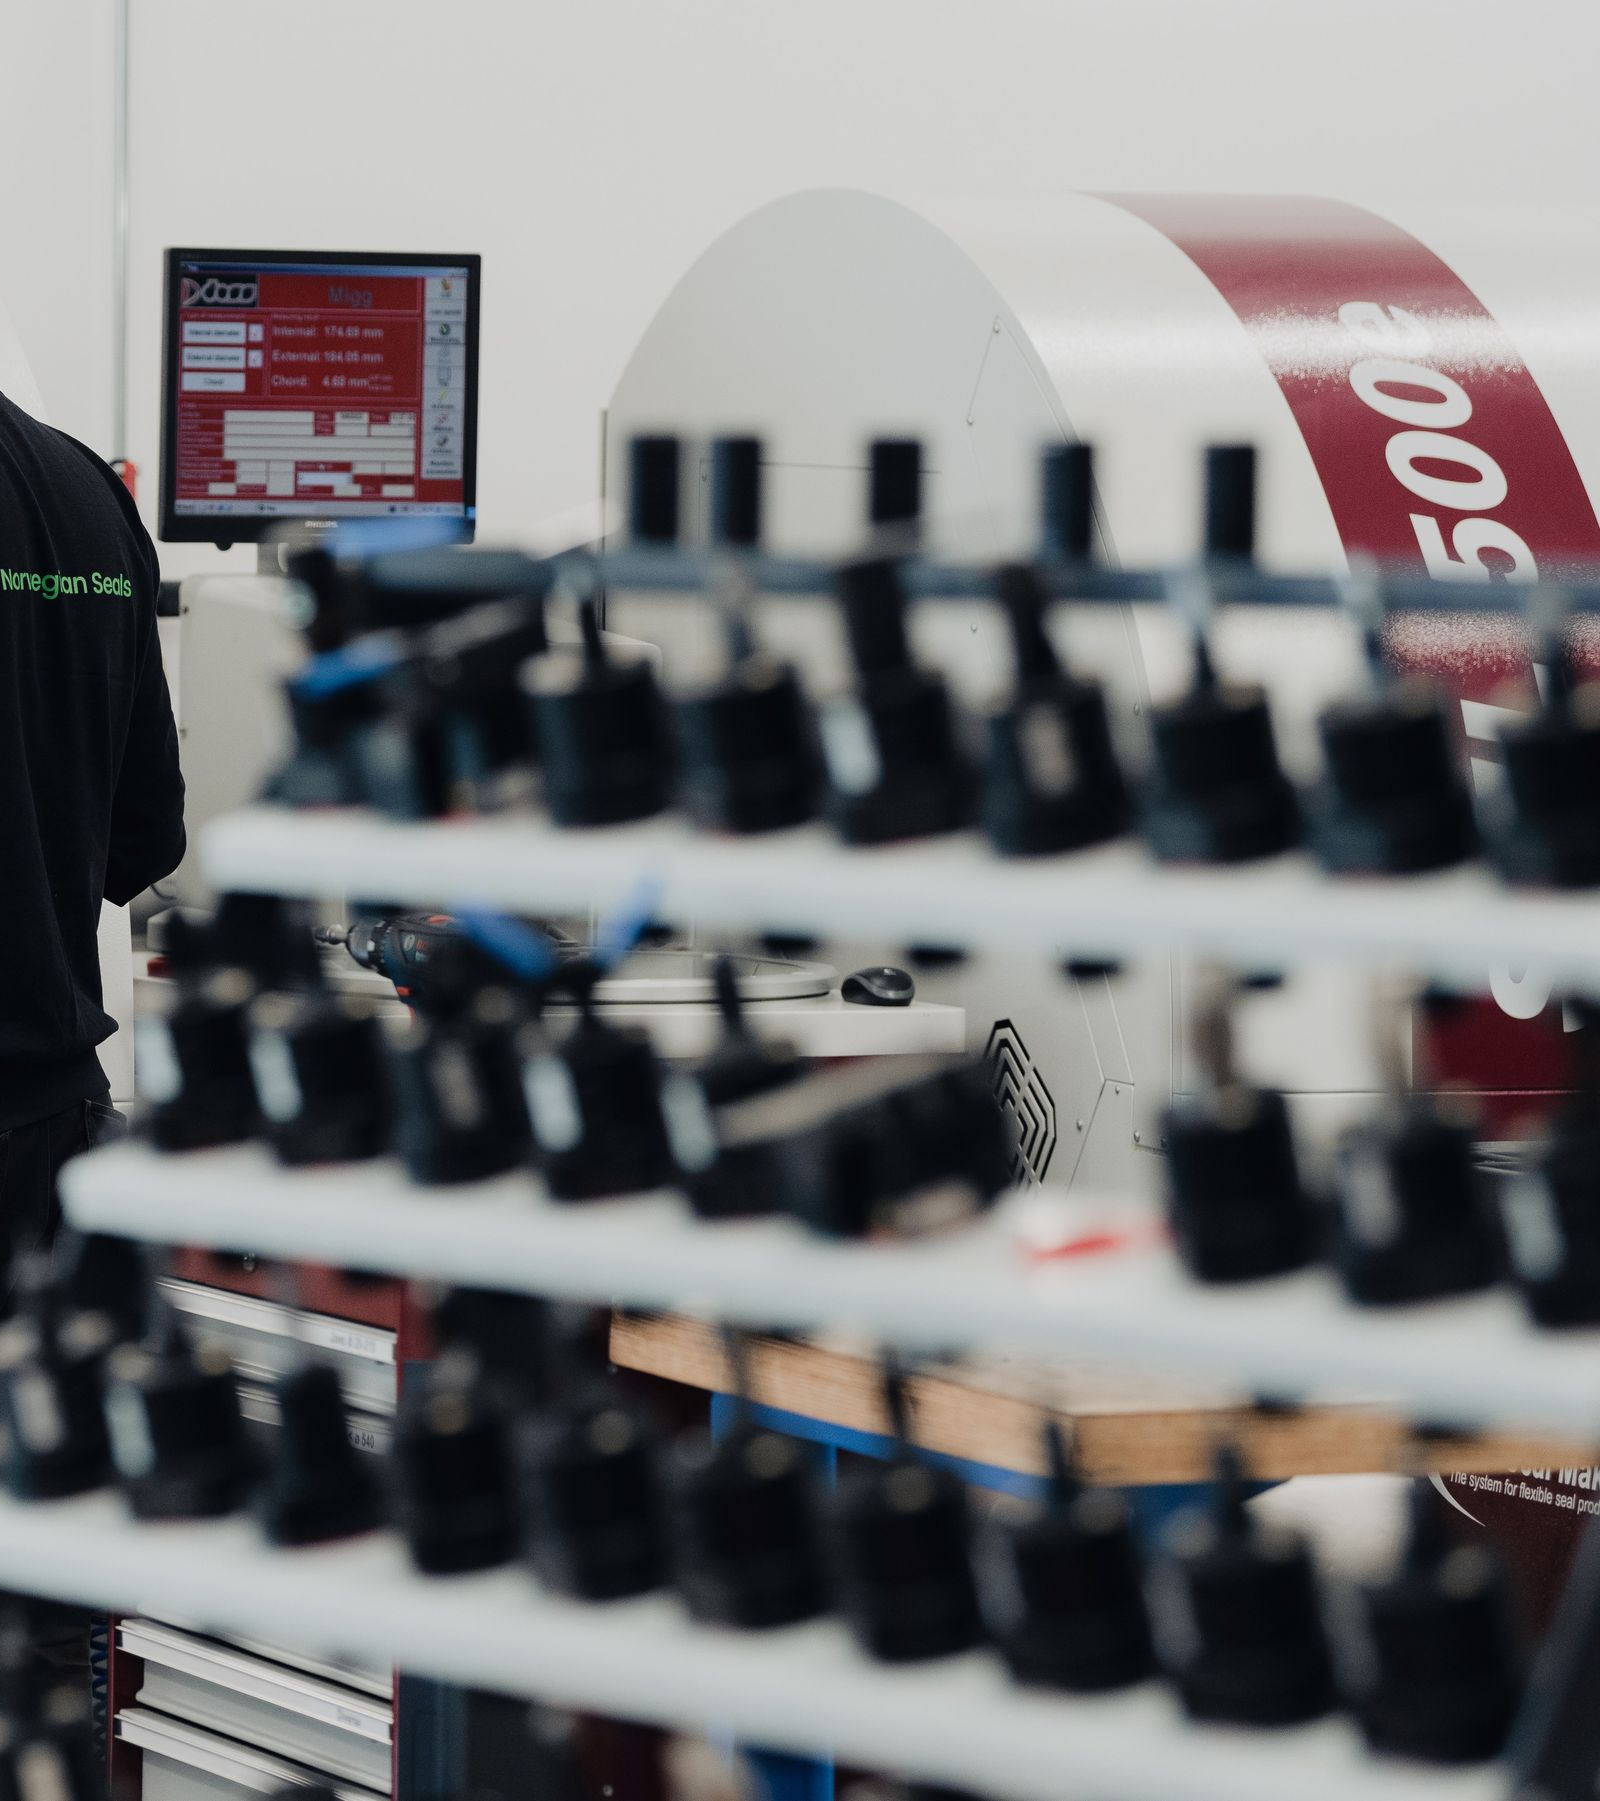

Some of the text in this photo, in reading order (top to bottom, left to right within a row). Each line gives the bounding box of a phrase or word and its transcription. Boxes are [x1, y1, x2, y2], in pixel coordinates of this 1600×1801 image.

[91, 571, 132, 597] Seals
[1468, 1474, 1503, 1493] system
[1503, 1478, 1519, 1497] for
[1518, 1481, 1553, 1505] flexible
[1554, 1493, 1577, 1510] seal
